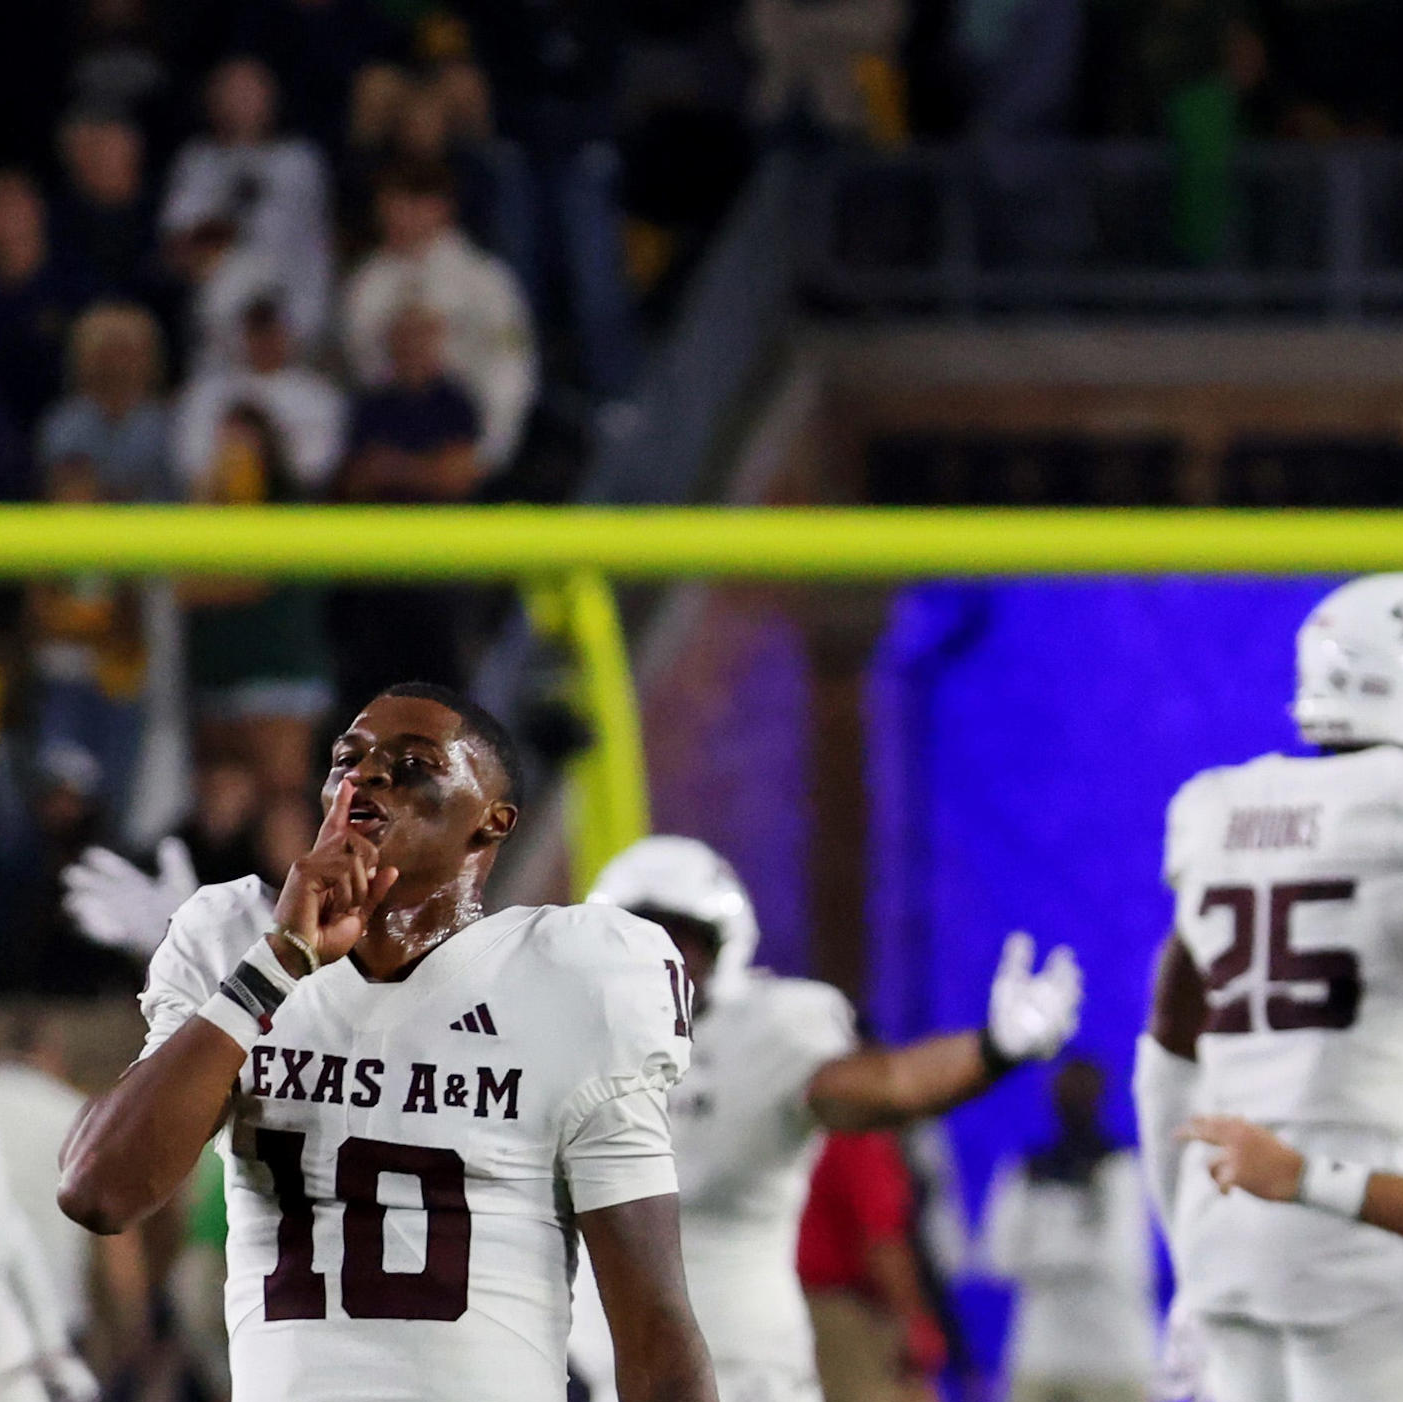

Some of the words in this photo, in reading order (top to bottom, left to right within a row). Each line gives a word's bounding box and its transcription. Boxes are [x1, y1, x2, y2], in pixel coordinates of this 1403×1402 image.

[1198, 878, 1362, 1036] 25
[250, 1044, 386, 1109] EXAS
[401, 1061, 524, 1121] A&M
[231, 1124, 473, 1323] 10
